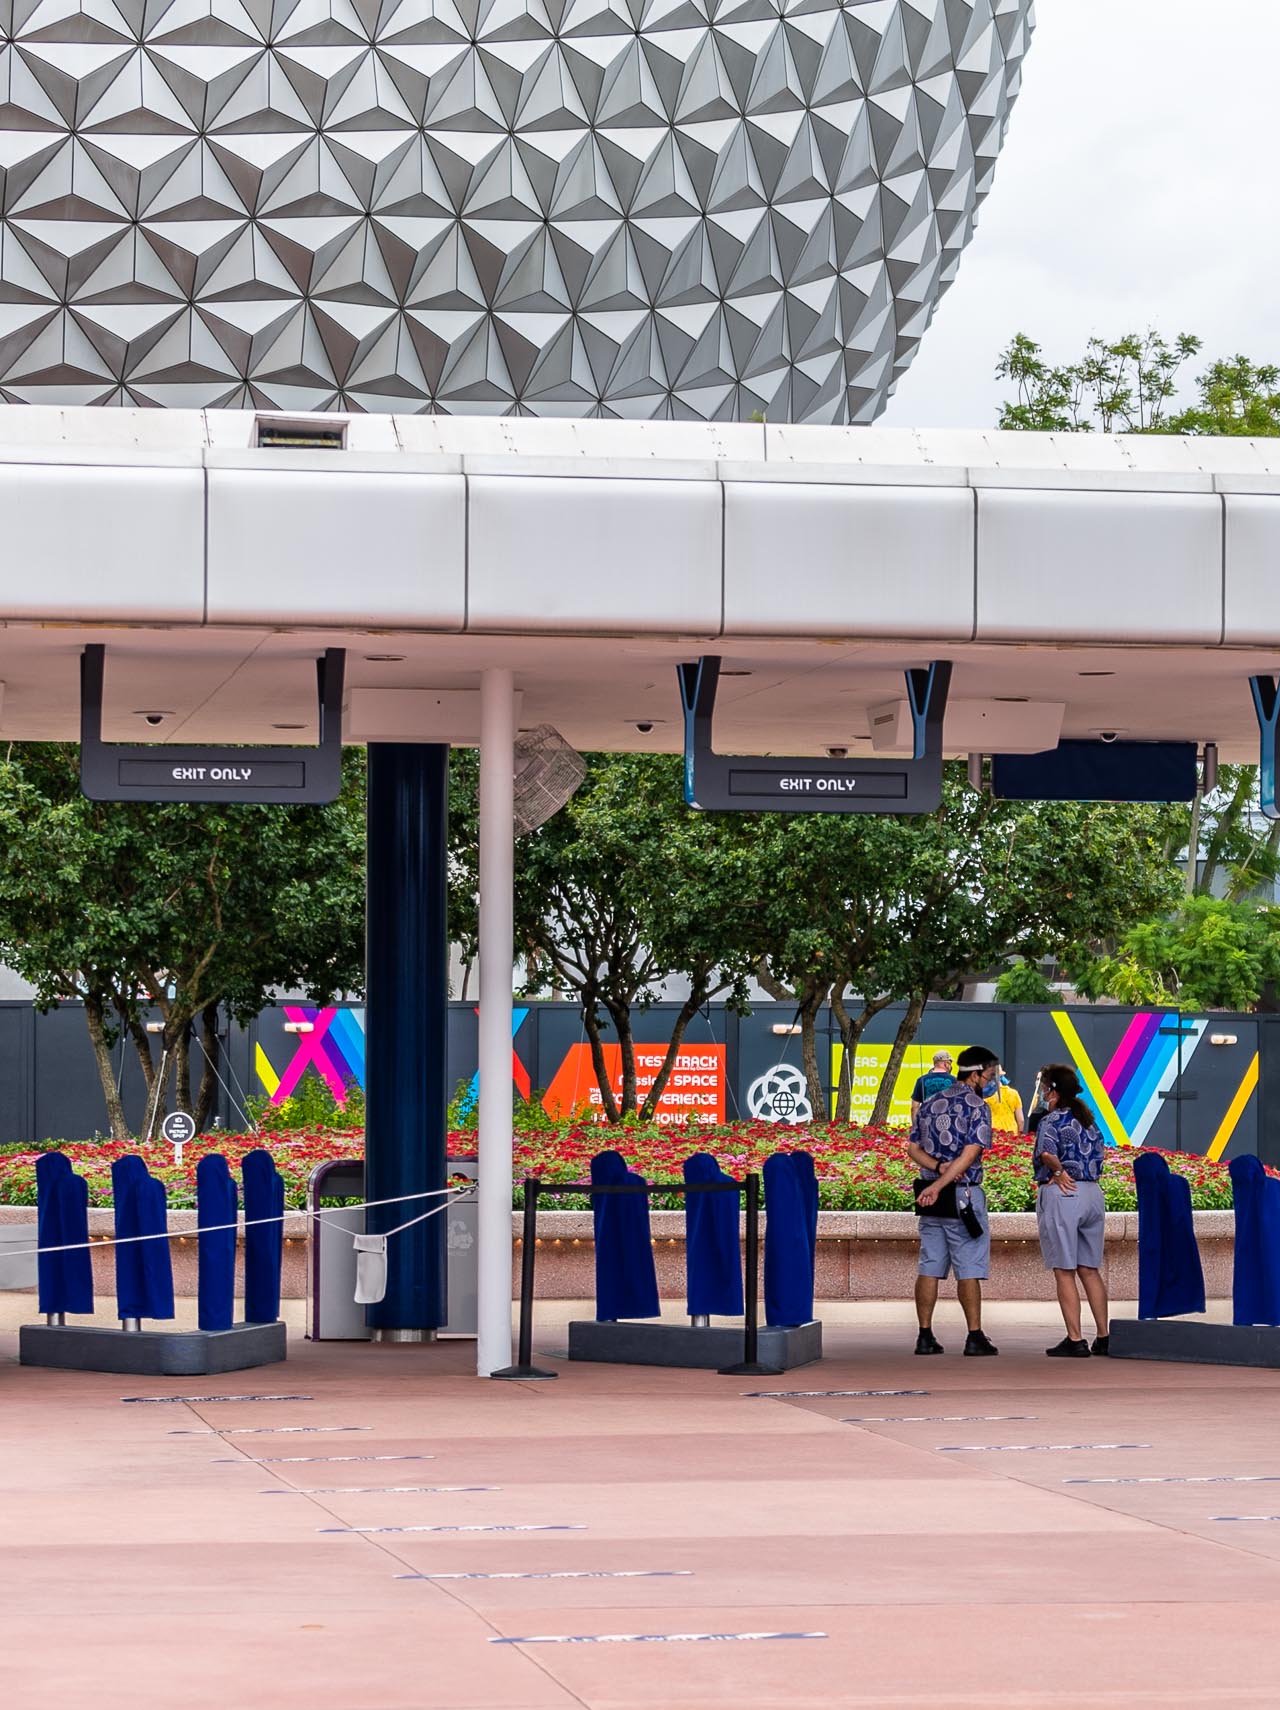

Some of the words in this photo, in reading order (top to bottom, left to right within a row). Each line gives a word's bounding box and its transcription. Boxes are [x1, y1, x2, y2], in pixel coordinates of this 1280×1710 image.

[172, 767, 207, 780] EXIT
[210, 767, 252, 781] ONLY
[779, 778, 813, 791] EXIT
[816, 778, 856, 791] ONLY
[674, 1075, 718, 1086] SPACE
